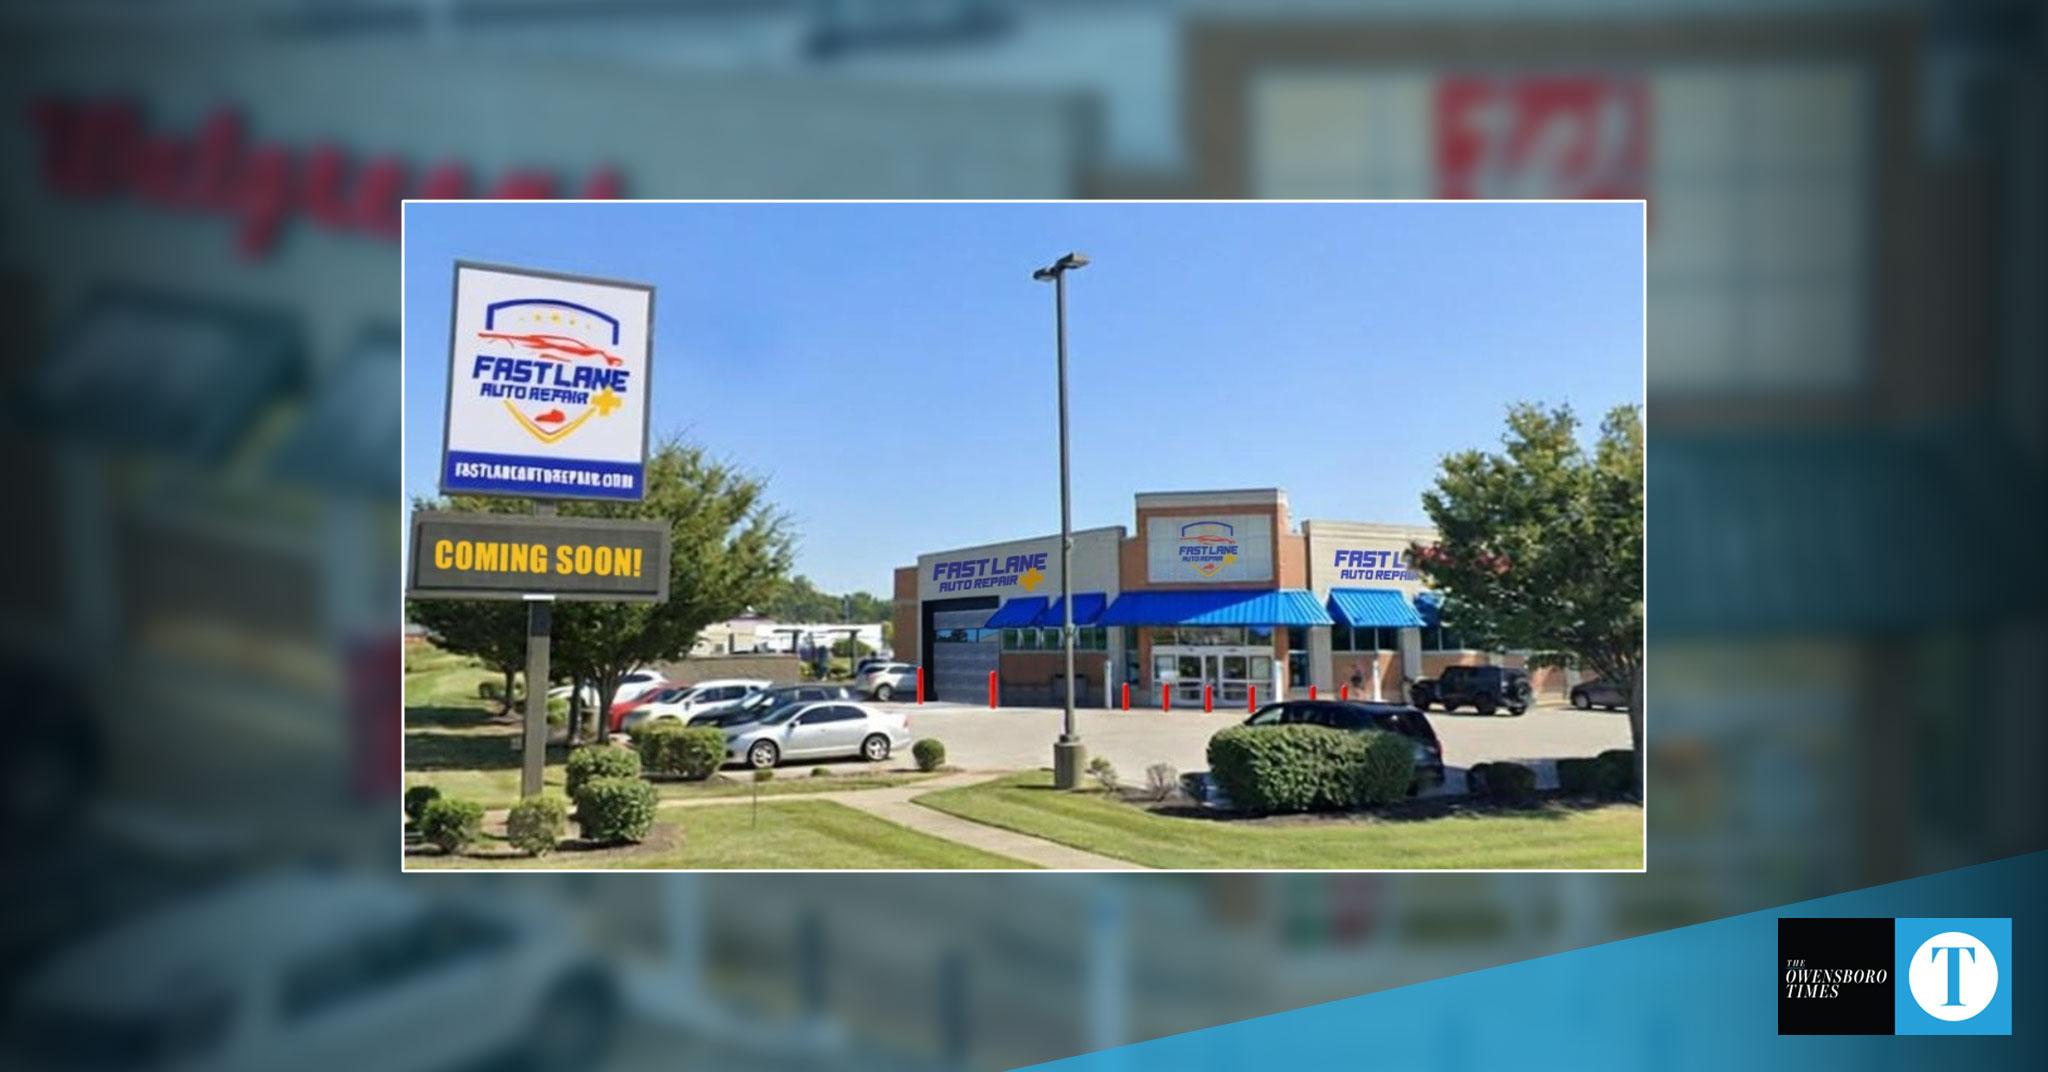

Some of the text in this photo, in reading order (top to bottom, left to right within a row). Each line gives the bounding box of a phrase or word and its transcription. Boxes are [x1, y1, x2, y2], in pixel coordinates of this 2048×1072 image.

[480, 382, 590, 405] AUTO REPAIR
[435, 540, 643, 577] COMING SOON!
[1334, 550, 1391, 568] FAST
[1340, 569, 1374, 580] AUTO
[939, 575, 1018, 593] AUTO REPAIR
